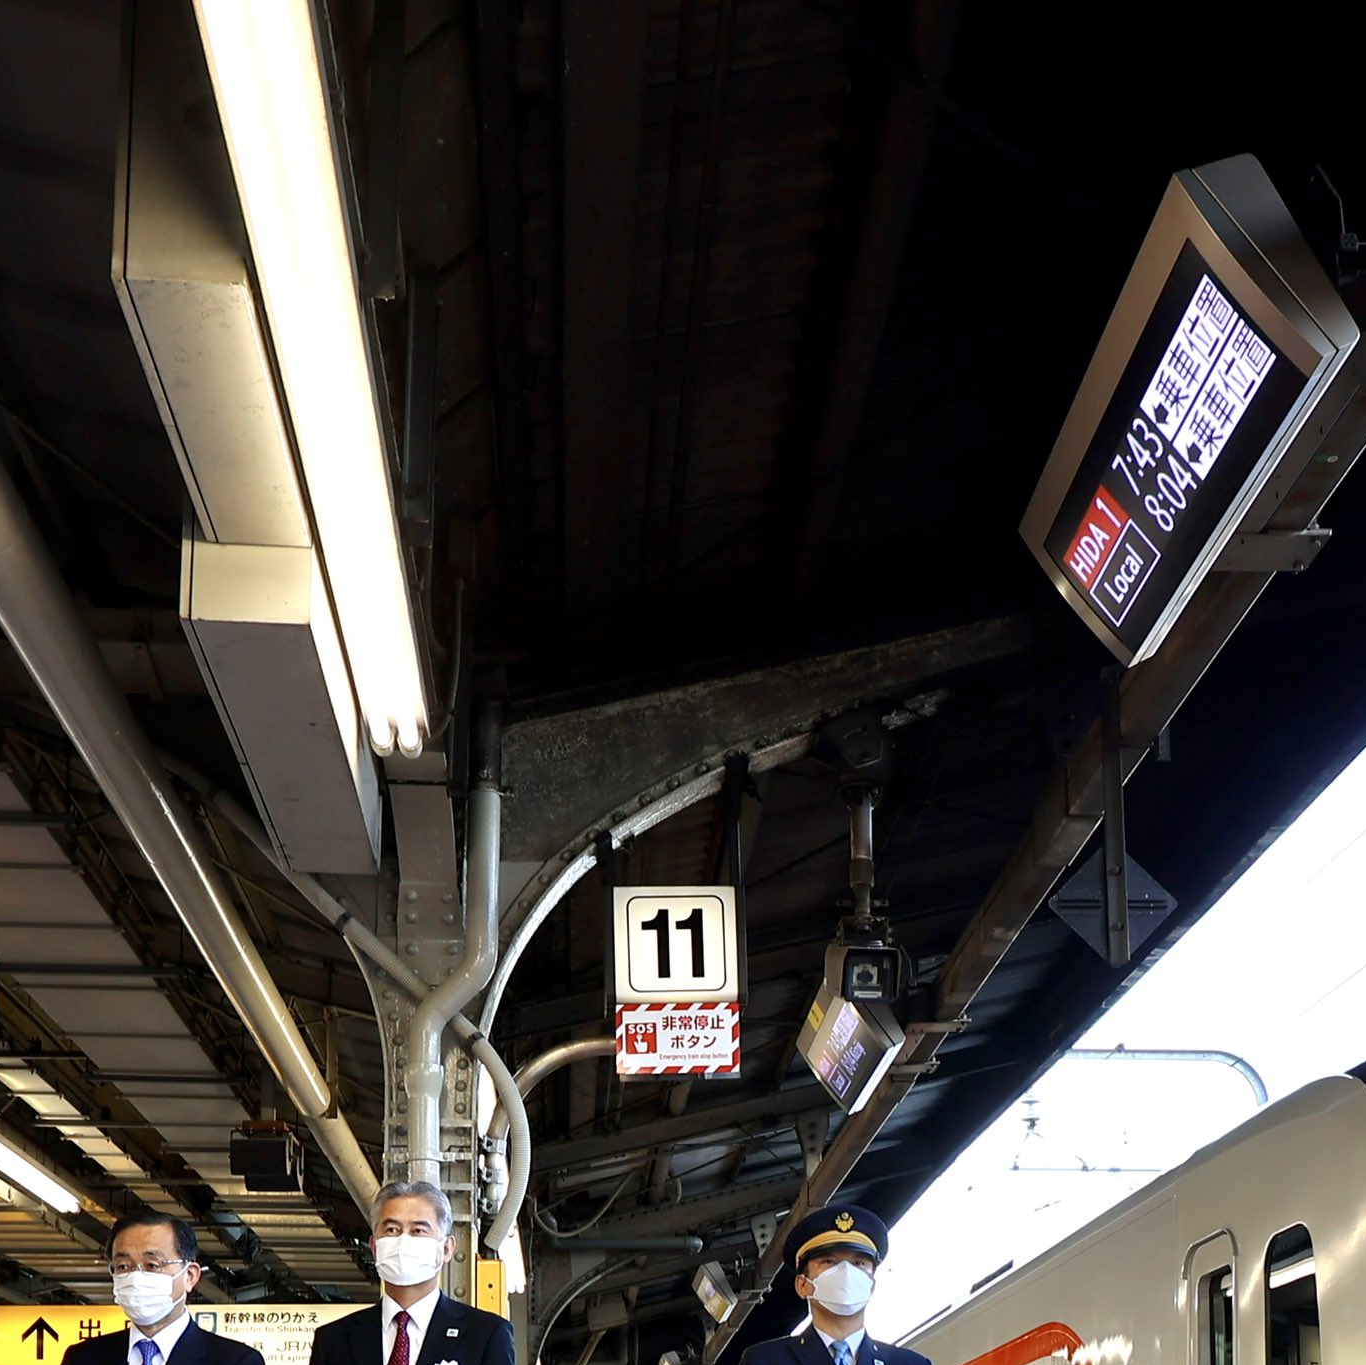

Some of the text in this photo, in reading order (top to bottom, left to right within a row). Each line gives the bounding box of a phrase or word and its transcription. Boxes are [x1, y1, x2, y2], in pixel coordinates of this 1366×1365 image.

[1070, 281, 1235, 584] HIDA 1 7:43 乗車位置
[1103, 318, 1274, 605] Local 8:04 乗車位置
[641, 908, 705, 979] 11
[628, 1023, 654, 1034] SOS
[662, 1015, 725, 1031] 非常停止
[670, 1034, 717, 1049] ボタン
[223, 1312, 320, 1324] 新幹線のりかえ
